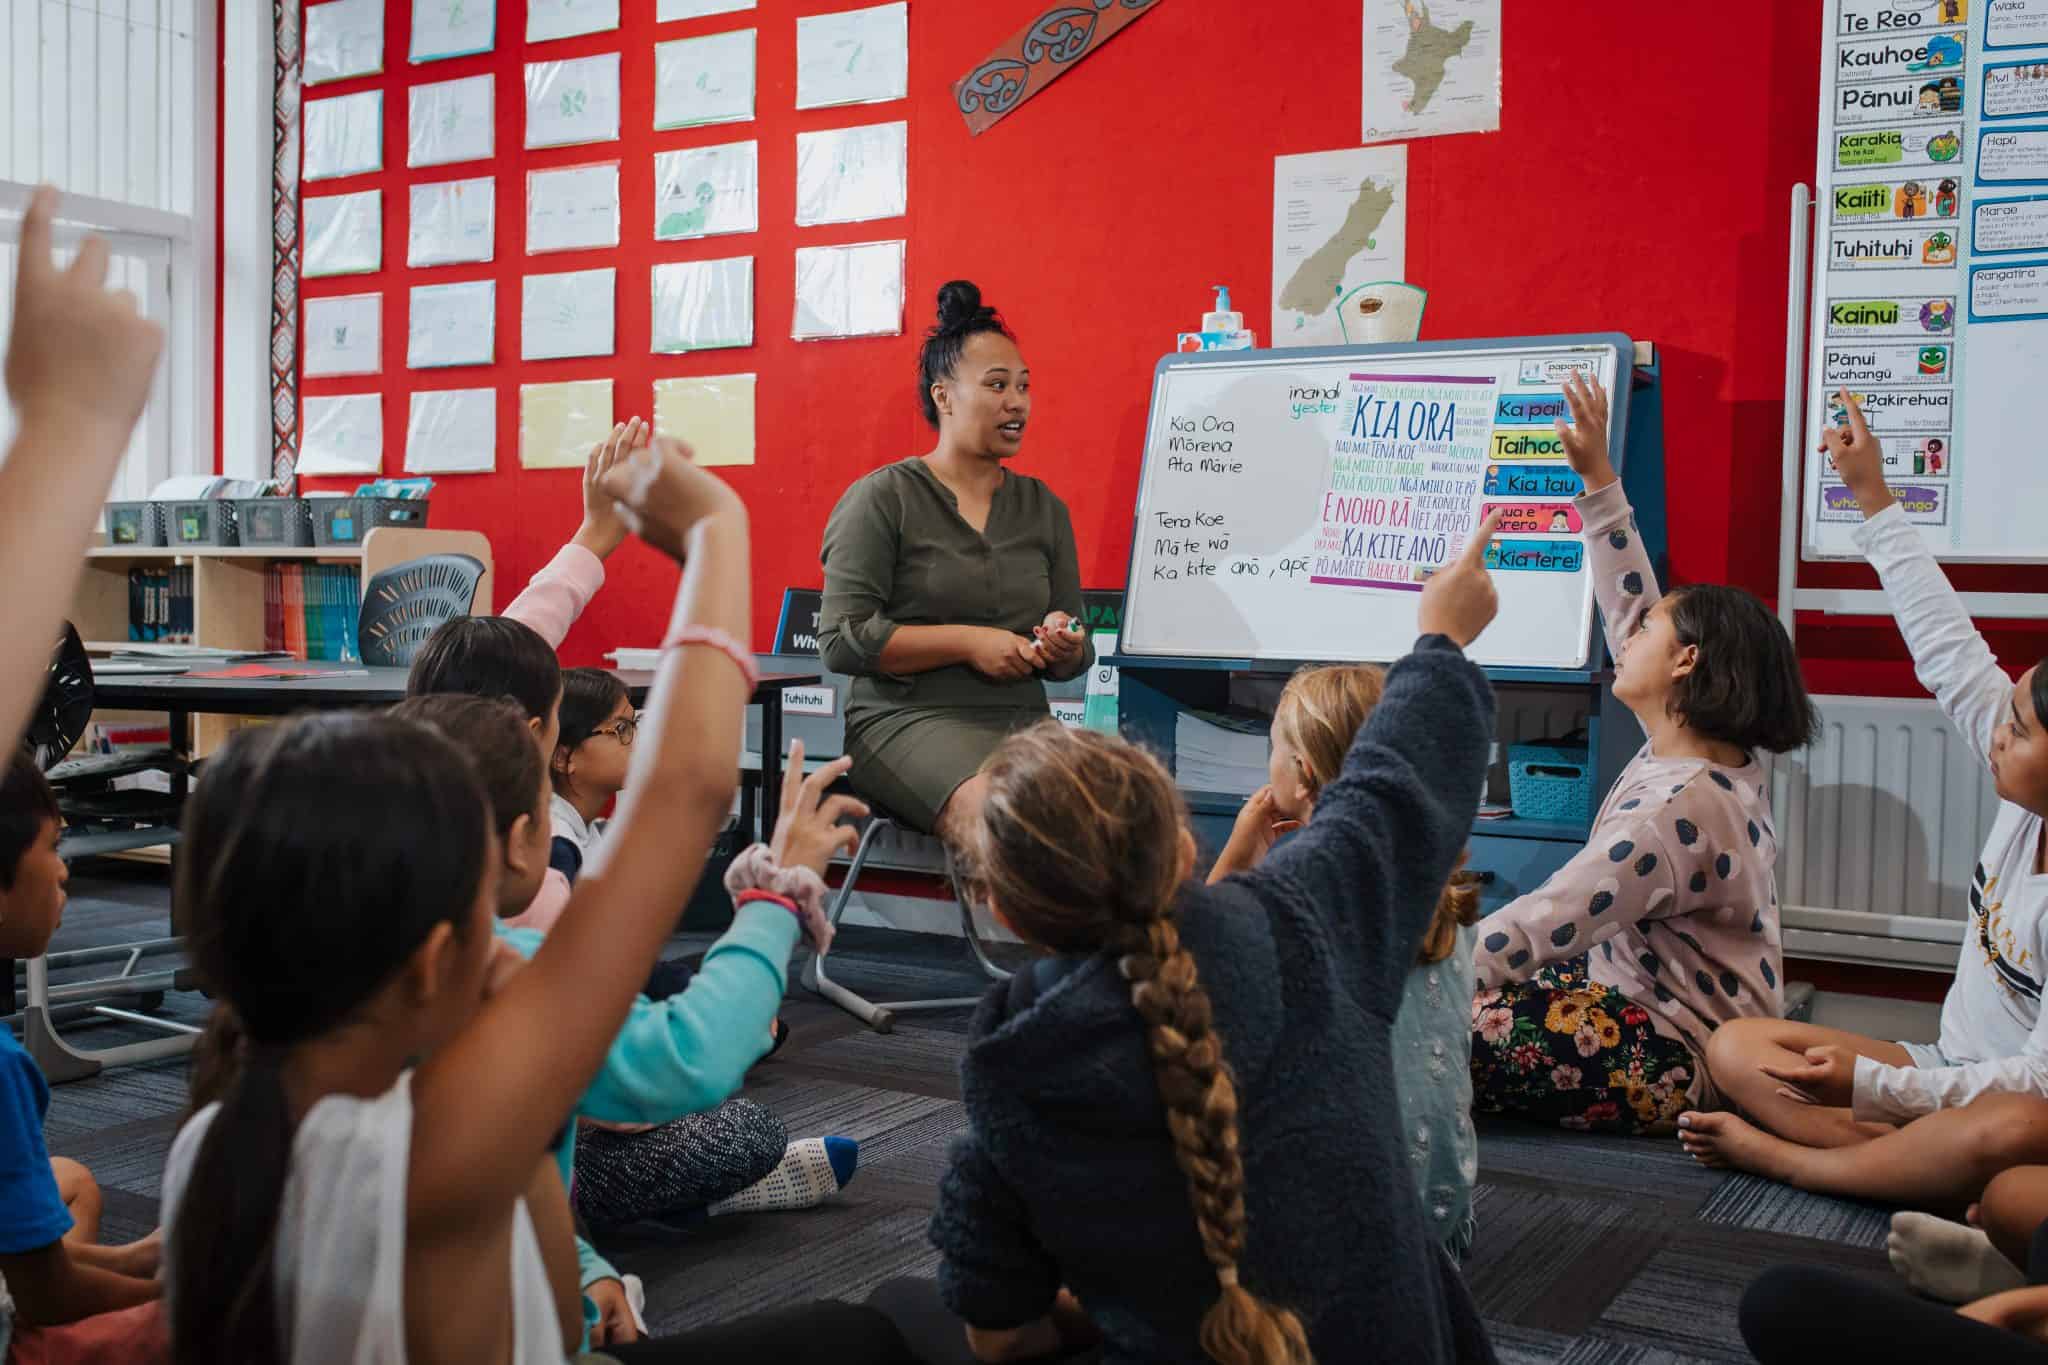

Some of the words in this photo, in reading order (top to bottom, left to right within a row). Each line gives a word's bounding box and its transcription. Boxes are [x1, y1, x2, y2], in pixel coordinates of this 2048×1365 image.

[1844, 13, 1868, 33] Te
[1877, 10, 1921, 28] Reo
[1840, 46, 1928, 68] Kauhoe
[1843, 85, 1913, 110] Pānui
[1839, 132, 1902, 148] Karakia
[1836, 189, 1886, 209] Kaiiti
[1980, 206, 2018, 217] Marae
[1834, 239, 1913, 258] Tuhituhi
[1976, 270, 2036, 282] Rangatira
[1830, 304, 1899, 325] Kainui
[1828, 351, 1876, 367] Pānui
[1866, 394, 1948, 407] Pakirehua
[1351, 394, 1401, 440] KIA
[1407, 400, 1456, 442] ORA
[1498, 400, 1523, 417] Ka
[1528, 399, 1565, 421] pai!
[1170, 415, 1196, 432] Kia
[1202, 415, 1235, 433] Ora
[1168, 436, 1233, 453] Mōrena
[1508, 474, 1538, 492] Kia
[1544, 475, 1575, 492] tau
[1195, 511, 1225, 527] Koe
[1323, 491, 1333, 522] E
[1335, 496, 1386, 527] NOHO
[1389, 496, 1413, 529] RĀ
[1526, 507, 1535, 518] e
[1184, 537, 1201, 553] te
[1342, 528, 1363, 558] KA
[1366, 533, 1406, 561] KITE
[1408, 533, 1446, 564] ANŌ
[1500, 549, 1528, 568] Kia
[1535, 551, 1579, 569] tere!
[1153, 564, 1178, 581] Ka
[1187, 557, 1217, 577] kite
[784, 693, 823, 706] Tuhituhi
